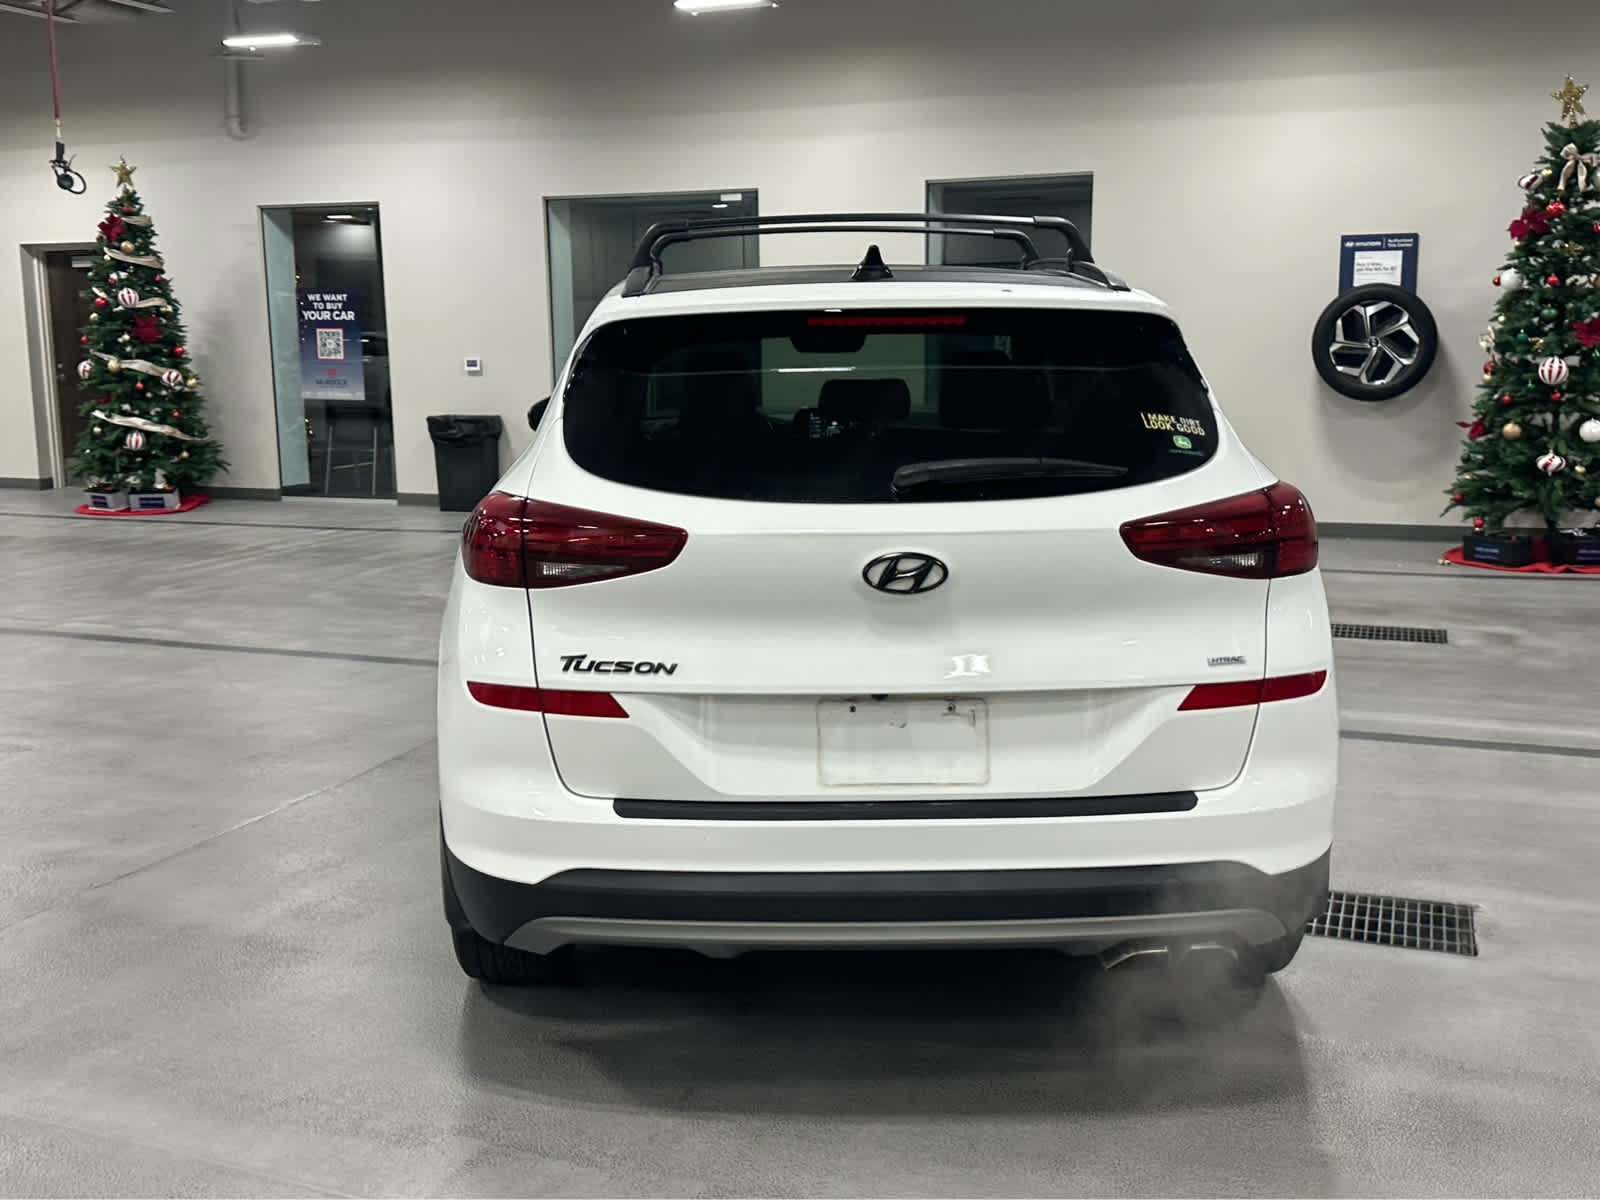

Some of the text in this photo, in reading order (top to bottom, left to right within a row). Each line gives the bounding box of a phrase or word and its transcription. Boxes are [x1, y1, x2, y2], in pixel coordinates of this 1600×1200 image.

[302, 310, 355, 320] YOUR CAR
[1176, 423, 1205, 436] GOOD
[560, 654, 678, 675] TUCSON
